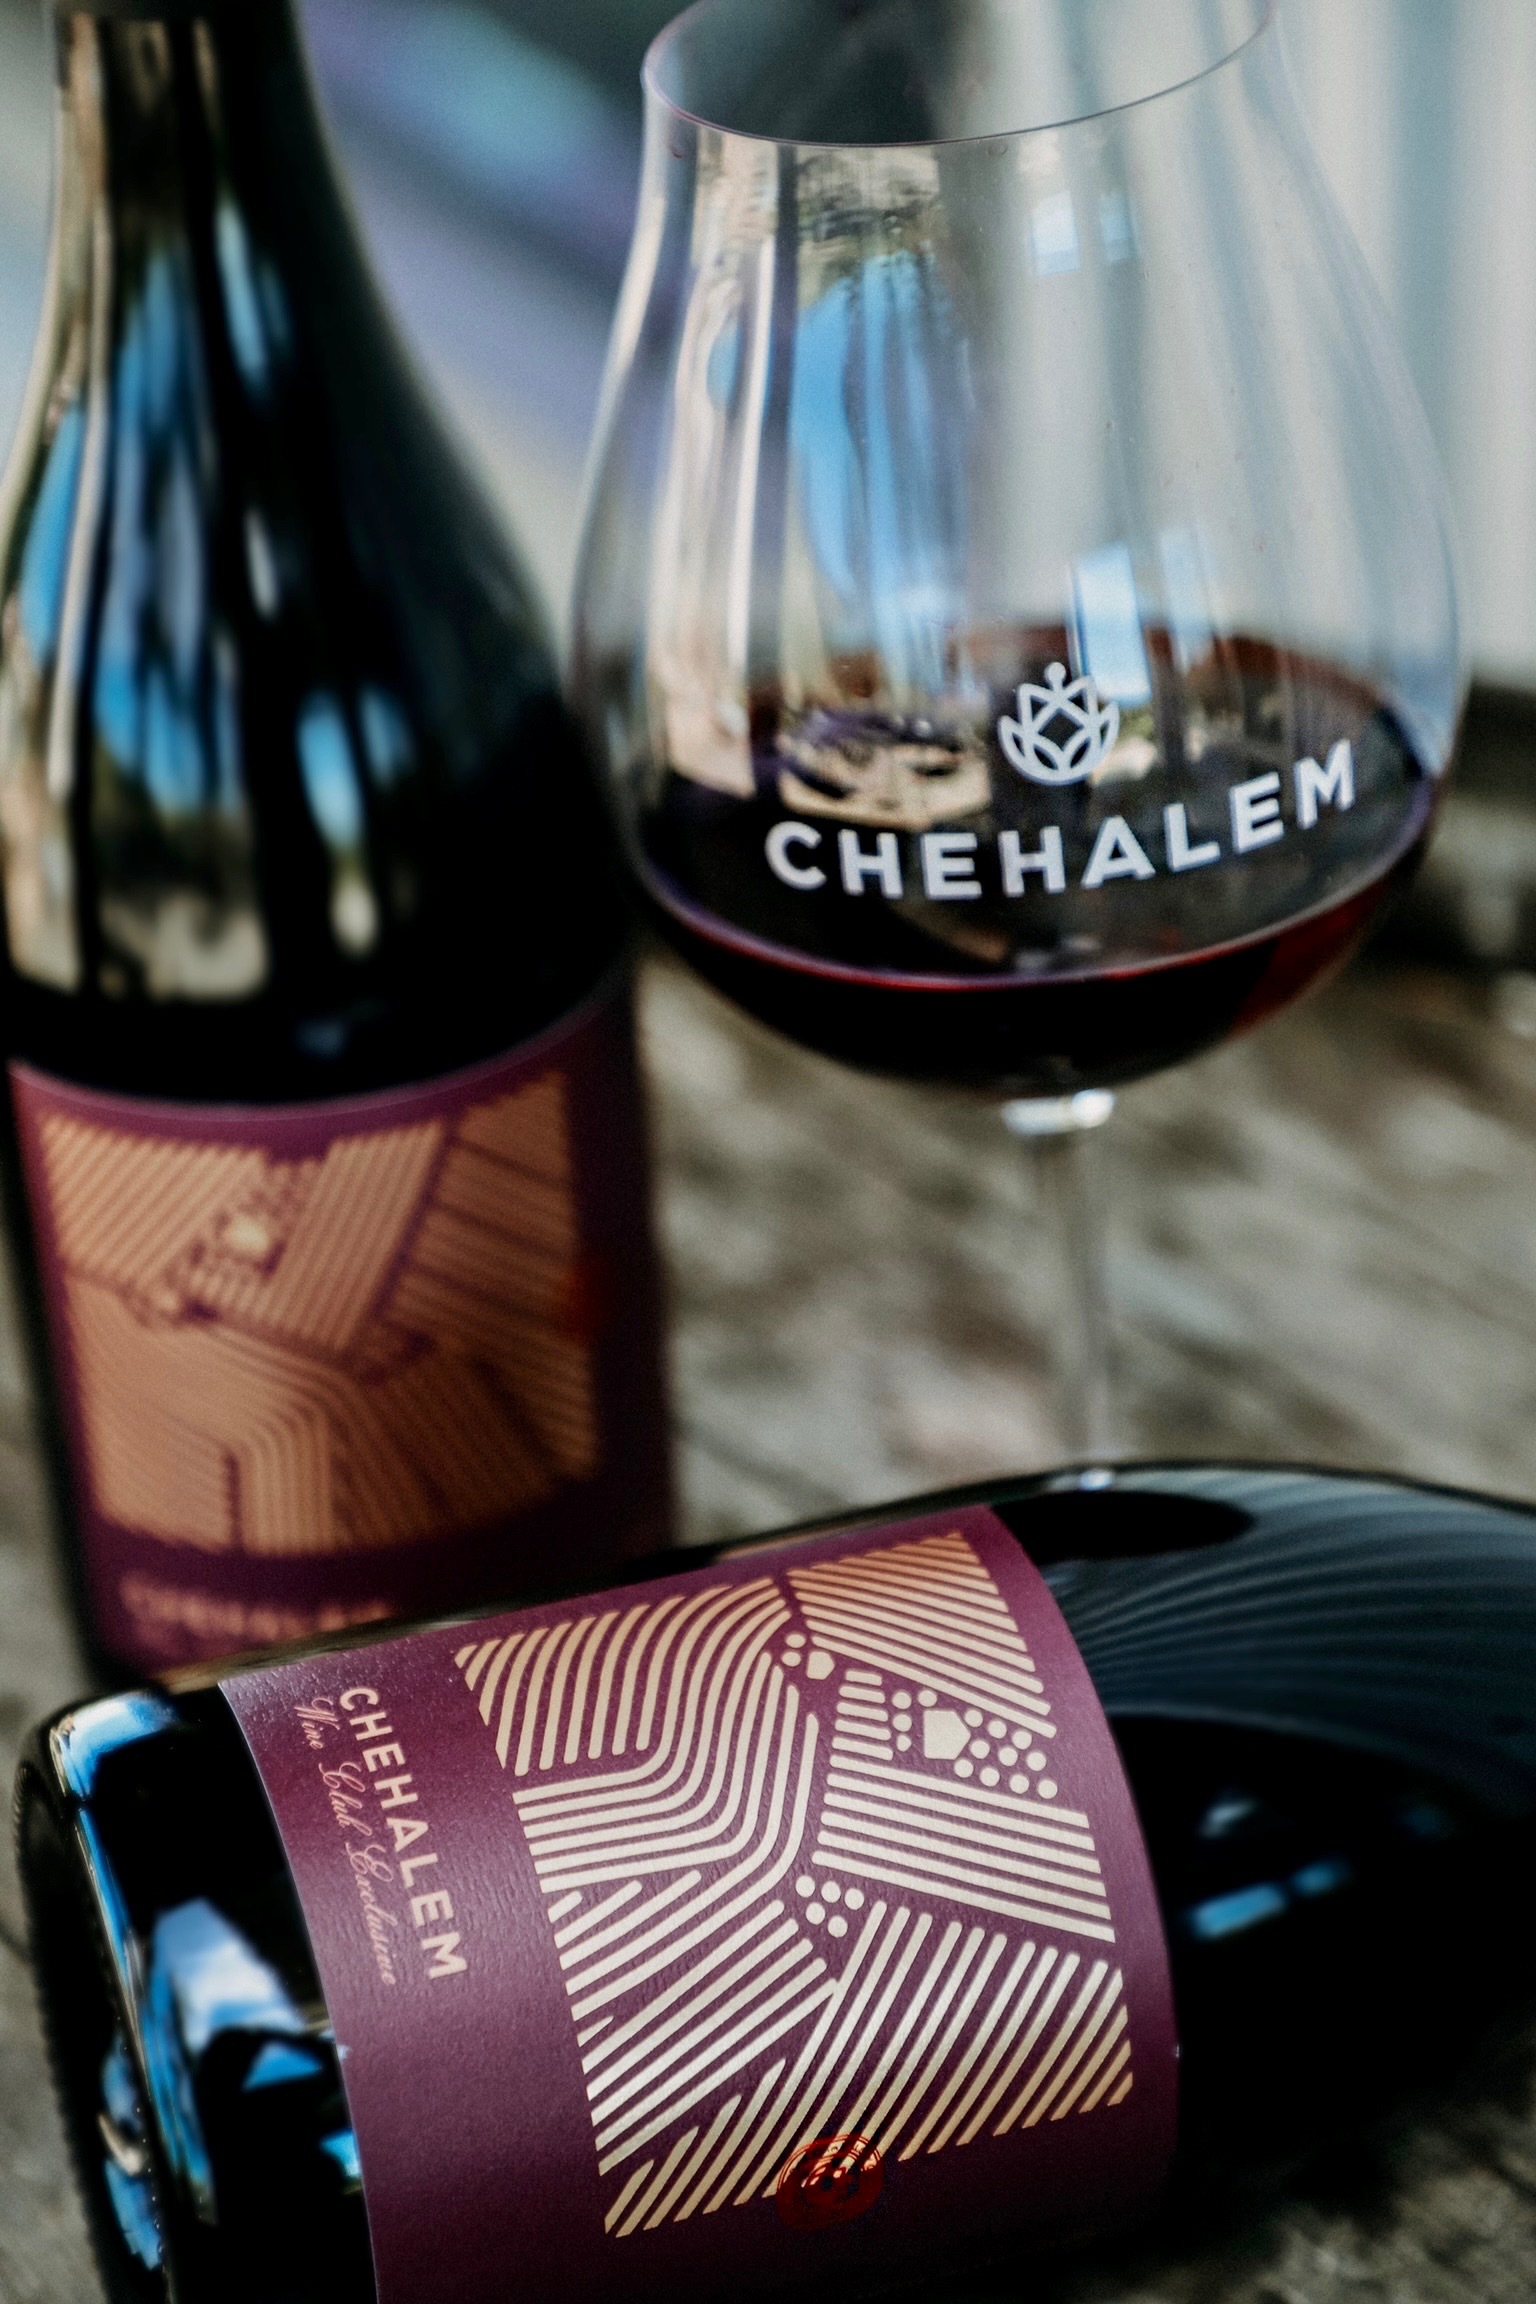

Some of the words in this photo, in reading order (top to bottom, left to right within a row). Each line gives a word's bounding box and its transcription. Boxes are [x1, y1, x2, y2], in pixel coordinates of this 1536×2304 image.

[765, 739, 1357, 900] CHEHALEM
[295, 1696, 341, 1750] Wine
[319, 1762, 373, 1836] Club
[340, 1686, 468, 1979] CHEHALEM
[345, 1842, 398, 1986] Exclusive
